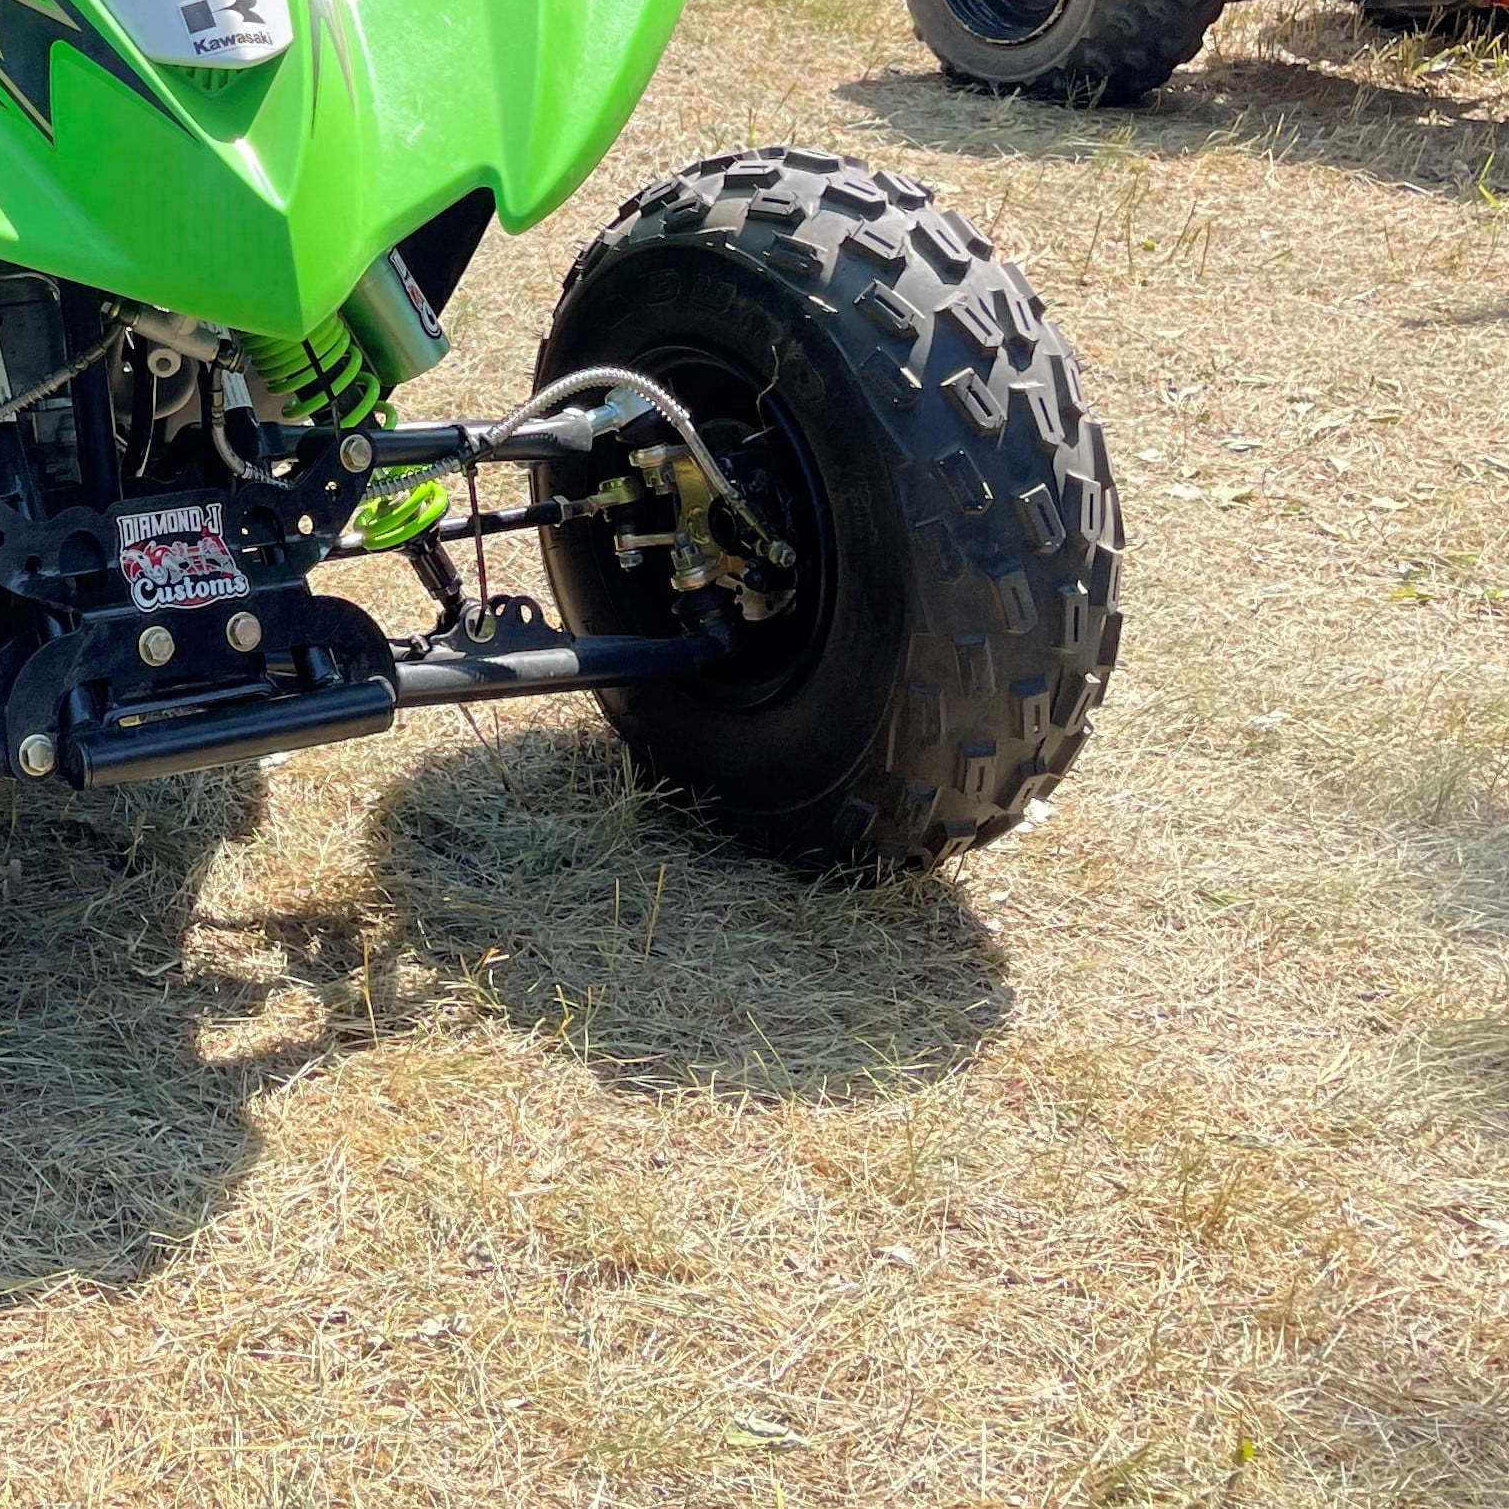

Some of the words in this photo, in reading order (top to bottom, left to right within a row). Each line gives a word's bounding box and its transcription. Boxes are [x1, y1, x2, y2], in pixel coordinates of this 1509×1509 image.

[193, 31, 274, 55] Kawasaki
[121, 508, 202, 548] DIAMOND
[133, 576, 247, 608] Customs
